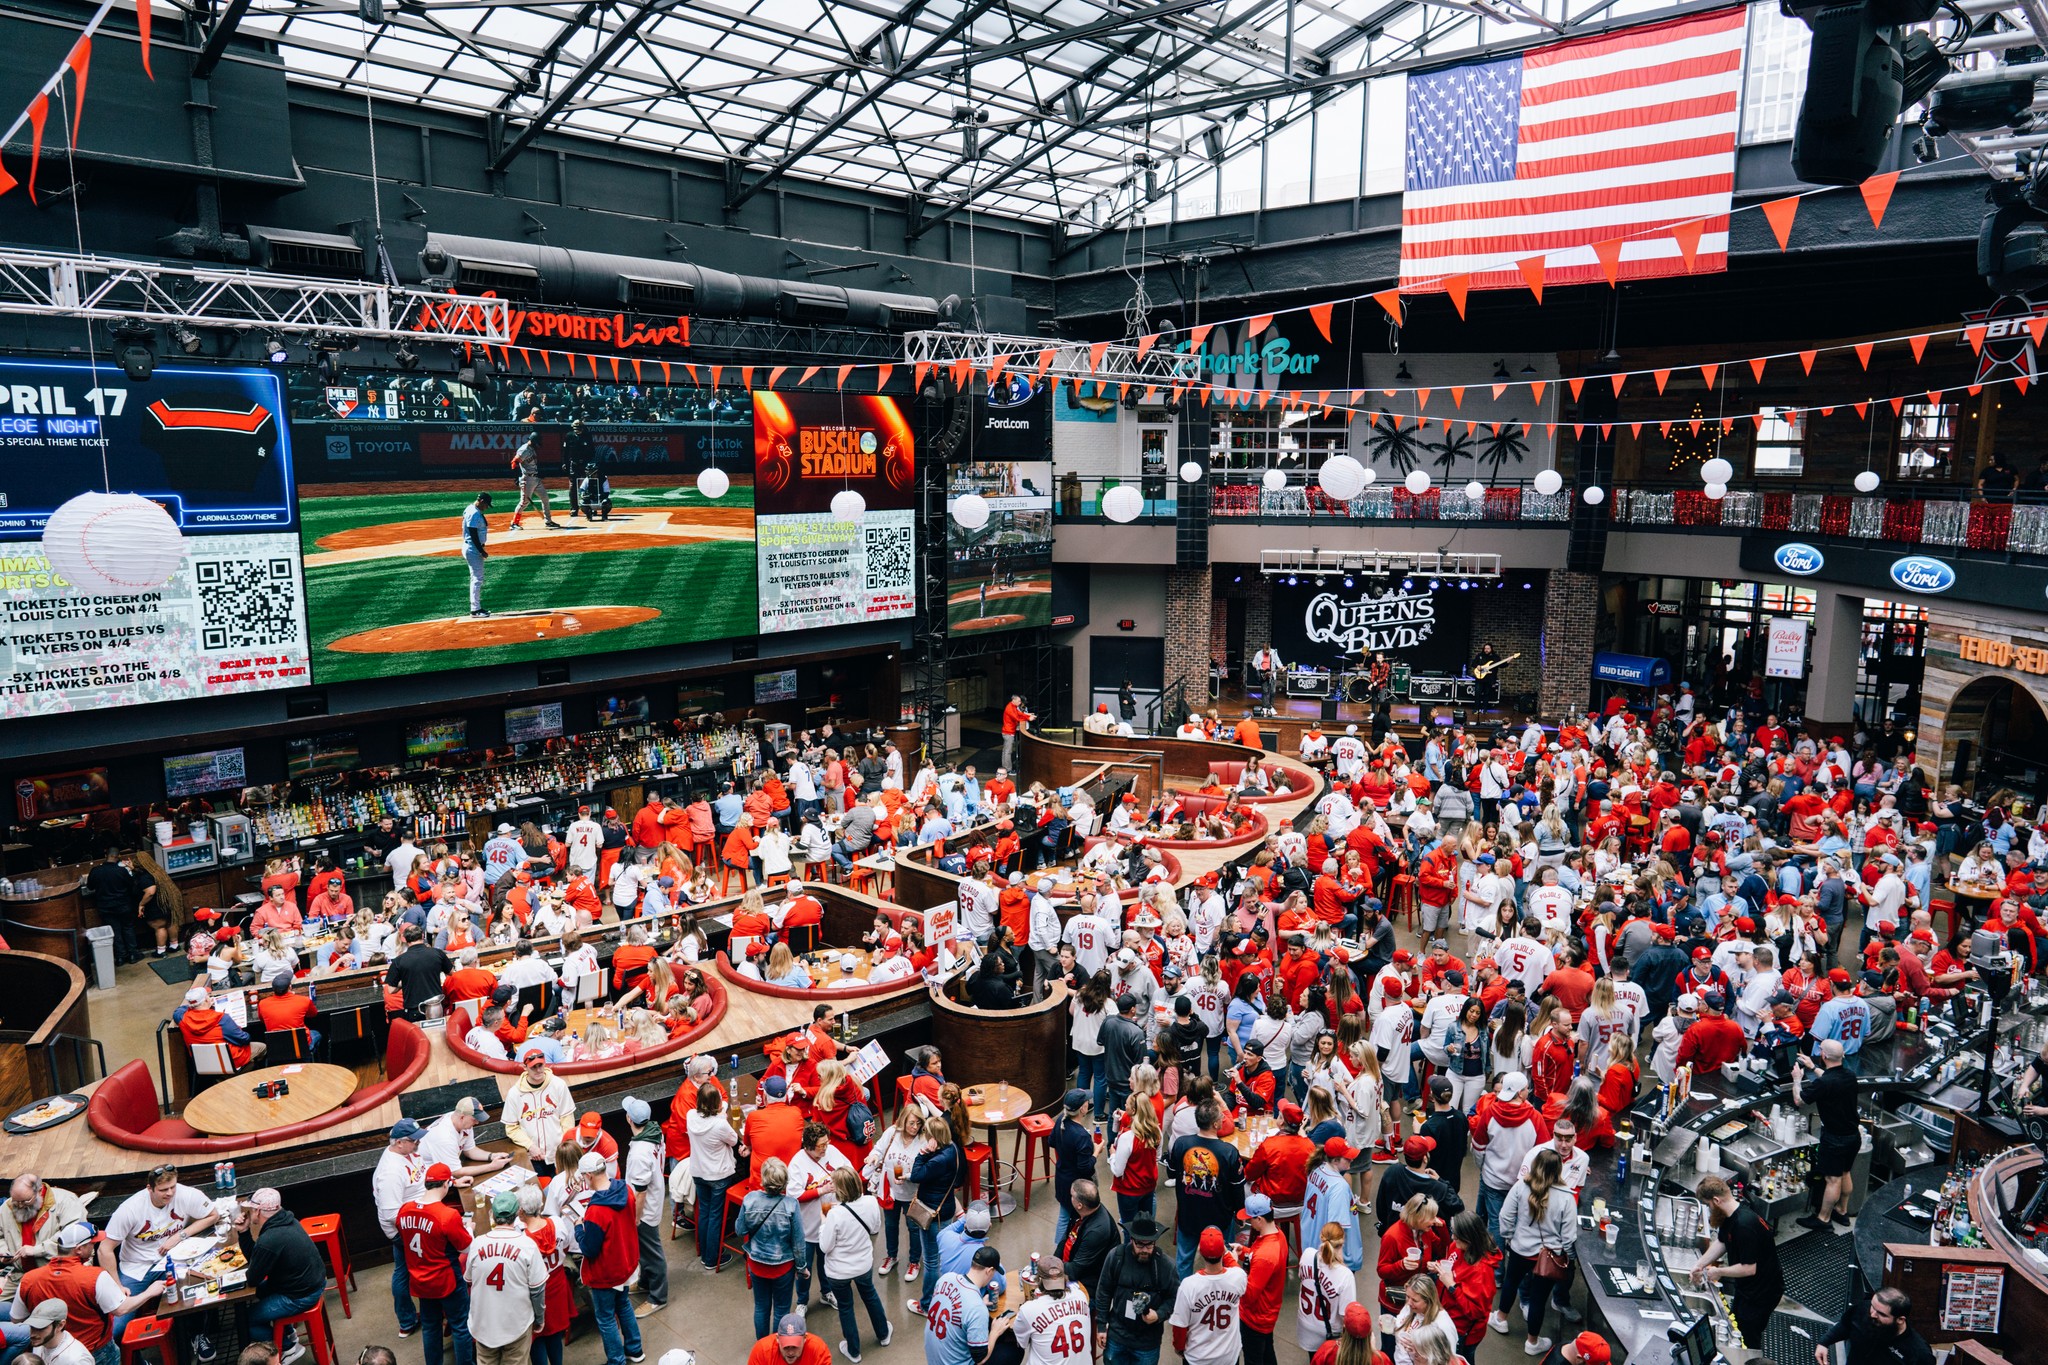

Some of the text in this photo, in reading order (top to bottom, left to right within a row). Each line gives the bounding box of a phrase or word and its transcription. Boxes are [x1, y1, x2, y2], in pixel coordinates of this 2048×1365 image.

[526, 312, 612, 342] SPORTS
[614, 313, 691, 349] Live!
[1261, 337, 1320, 375] Bar
[84, 388, 127, 416] 17
[328, 388, 356, 398] MLB
[47, 419, 99, 434] NIGHT
[7, 437, 110, 447] SPECIAL THEME TICKET
[355, 441, 413, 453] TOYOTA
[800, 431, 860, 454] BUSCH
[801, 453, 877, 475] STADIUM
[196, 513, 277, 522] CARDINALS.COM/THEME
[758, 523, 810, 535] ULTIMATE
[828, 521, 855, 532] LOUIS
[760, 535, 800, 547] SPORTS
[778, 551, 807, 560] TICKETS
[818, 549, 840, 557] CHEER
[781, 559, 801, 568] LOUIS
[802, 558, 817, 566] CITY
[1783, 547, 1813, 571] Ford
[780, 574, 809, 583] TICKETS
[819, 571, 840, 580] BLUES
[1902, 561, 1942, 588] Ford
[784, 581, 811, 590] FLYERS
[811, 580, 821, 588] ON
[3, 592, 162, 612] TICKETS TO CHEER ON
[790, 597, 818, 607] TICKETS
[819, 596, 829, 604] TO
[829, 595, 842, 603] THE
[10, 609, 54, 623] LOUIS
[57, 608, 91, 619] CITY
[94, 606, 113, 617] SC
[116, 604, 136, 615] ON
[138, 603, 159, 614] 4/1
[762, 606, 815, 618] BATTLEHAWKS
[815, 604, 834, 612] GAME
[1305, 592, 1435, 648] QUEENS
[1122, 620, 1132, 628] EXIT
[10, 624, 165, 645] TICKETS TO BLUES VS
[1772, 630, 1802, 644] Bally
[22, 638, 131, 656] FLYERS ON 4/4
[1774, 645, 1798, 654] Live!
[1959, 635, 2013, 667] TENGO
[220, 655, 290, 670] SCAN FOR A
[8, 661, 150, 683] -5X TICKETS TO THE
[93, 673, 135, 687] GAME
[137, 671, 157, 682] ON
[159, 668, 182, 681] 4/8
[207, 667, 307, 685] CHANCE TO WIN!
[1599, 665, 1642, 679] BUD LIGHT
[1340, 748, 1354, 760] 28
[805, 770, 811, 783] 7
[580, 833, 588, 847] 4
[819, 827, 829, 842] 2
[490, 850, 508, 864] 46
[961, 892, 975, 912] 28
[1538, 892, 1563, 900] PUJOLS
[930, 909, 955, 927] Bally
[1546, 904, 1557, 921] 5
[933, 925, 952, 941] Live!
[1199, 926, 1208, 935] 50
[1078, 932, 1094, 950] 19
[1510, 942, 1536, 956] PUJOLS
[589, 957, 597, 973] 4
[1512, 953, 1527, 973] 5
[1197, 993, 1217, 1012] 46
[1598, 1023, 1625, 1045] 55
[1841, 1018, 1862, 1041] 28
[1306, 1192, 1318, 1219] 4
[399, 1215, 435, 1236] MOLINA
[409, 1232, 424, 1259] 4
[477, 1244, 522, 1263] MOLINA
[486, 1262, 506, 1292] 4
[1300, 1286, 1332, 1322] 50
[927, 1301, 951, 1340] 46
[1200, 1304, 1232, 1331] 46
[1051, 1319, 1085, 1358] 46
